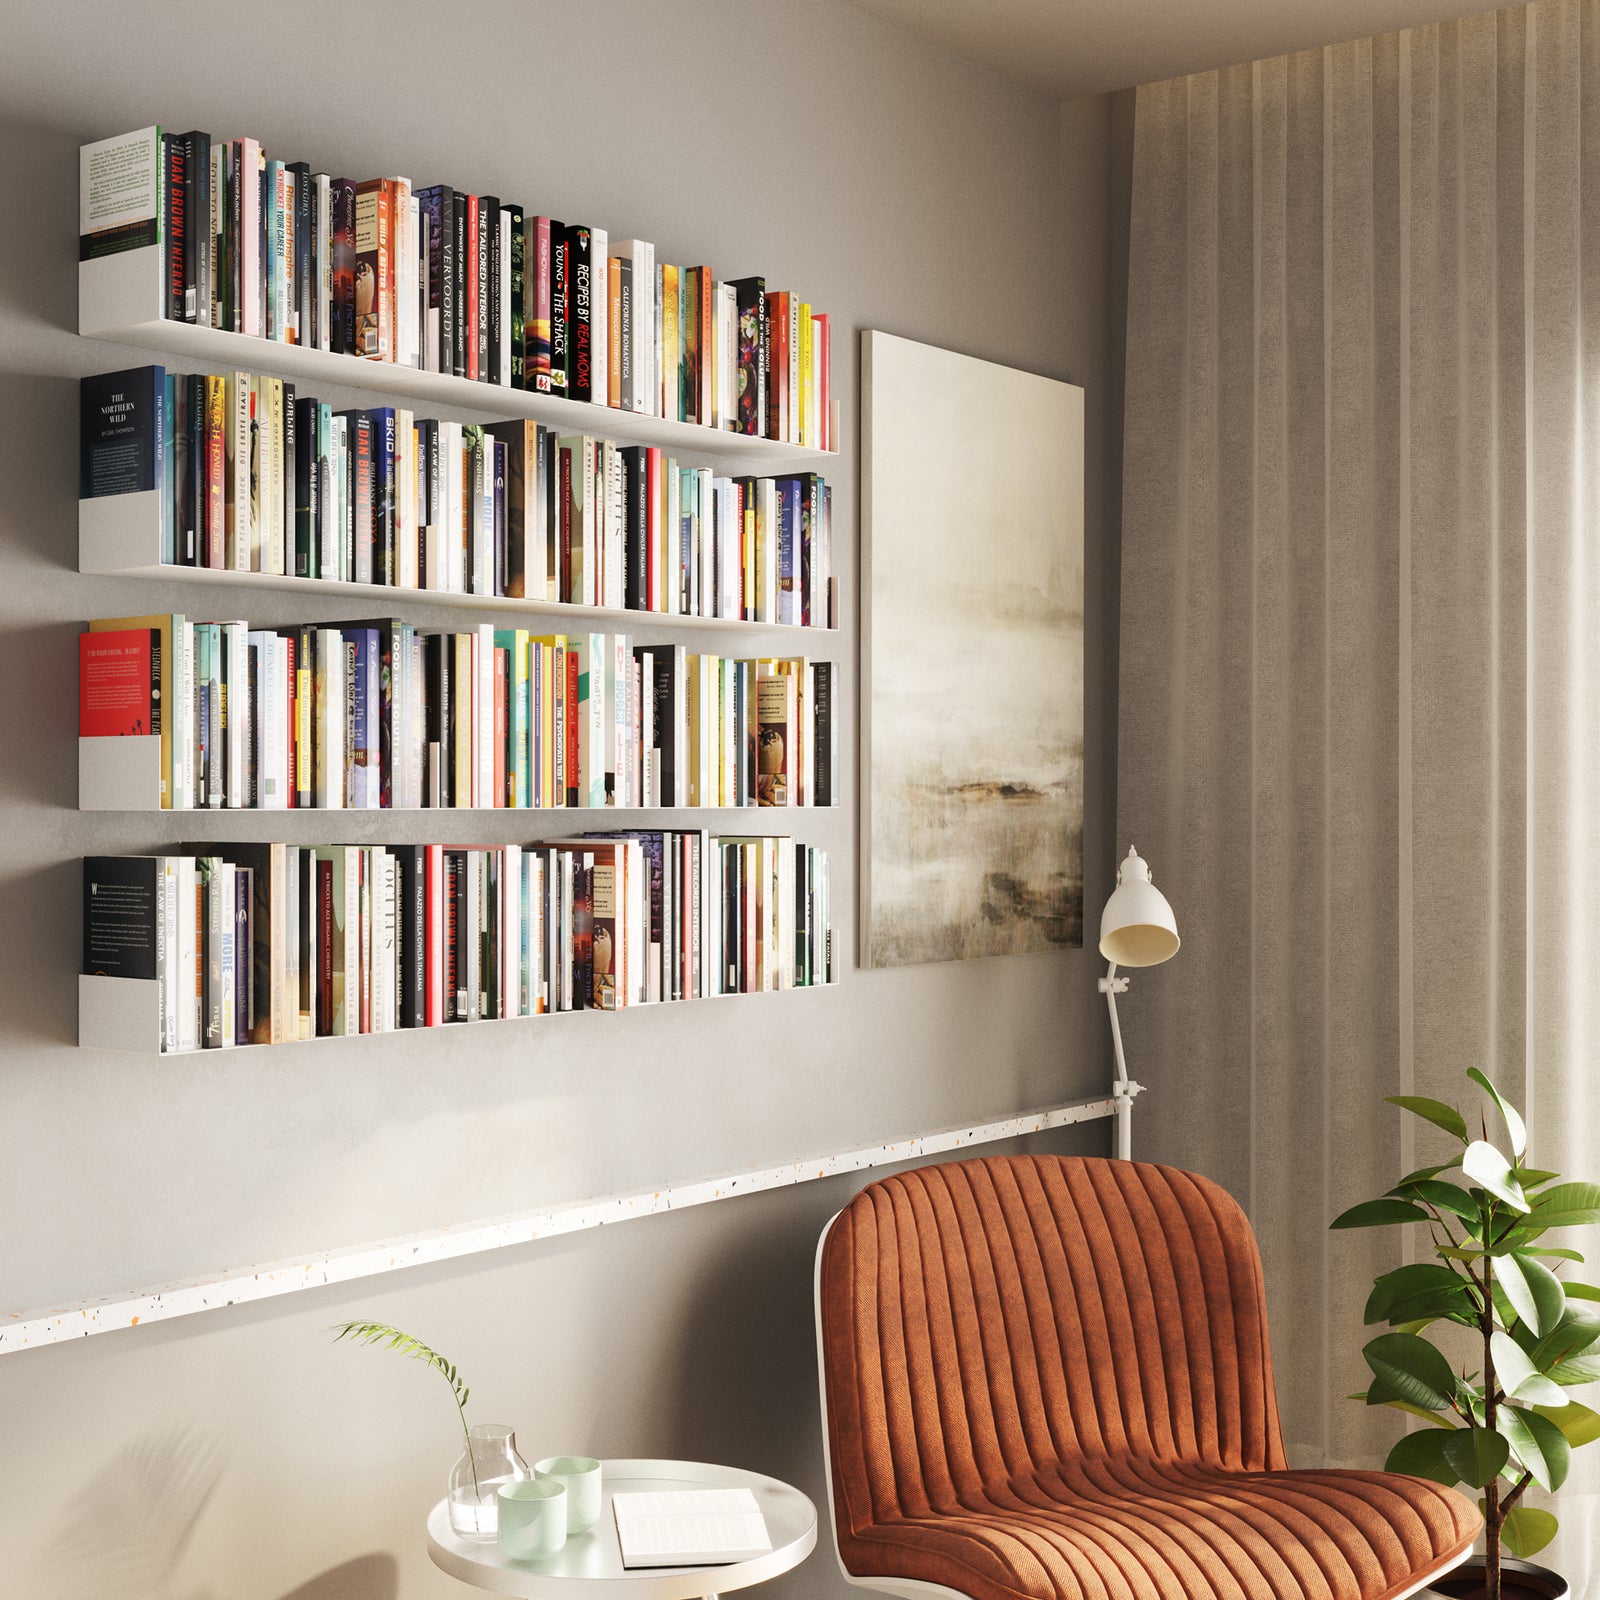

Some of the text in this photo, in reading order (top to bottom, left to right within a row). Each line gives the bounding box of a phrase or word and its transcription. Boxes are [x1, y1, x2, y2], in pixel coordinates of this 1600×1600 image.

[171, 155, 184, 296] DAN BROWN INFERNO
[276, 168, 284, 256] SKYROCKET YOUR CAREER
[286, 185, 294, 278] Rise and Inspire
[554, 245, 564, 355] YOUNG THE SHACK
[578, 264, 588, 388] RECIPES BY REAL MOMS
[101, 402, 135, 414] NORTHERN
[112, 393, 124, 402] THE
[109, 414, 126, 423] WILD
[432, 468, 438, 477] OF
[359, 430, 368, 558] DAN BROWN INFERNO
[152, 647, 160, 680] STEINBECK
[448, 874, 456, 898] DAN
[158, 913, 164, 922] OF
[448, 903, 456, 945] BROWN
[222, 933, 232, 972] MORE
